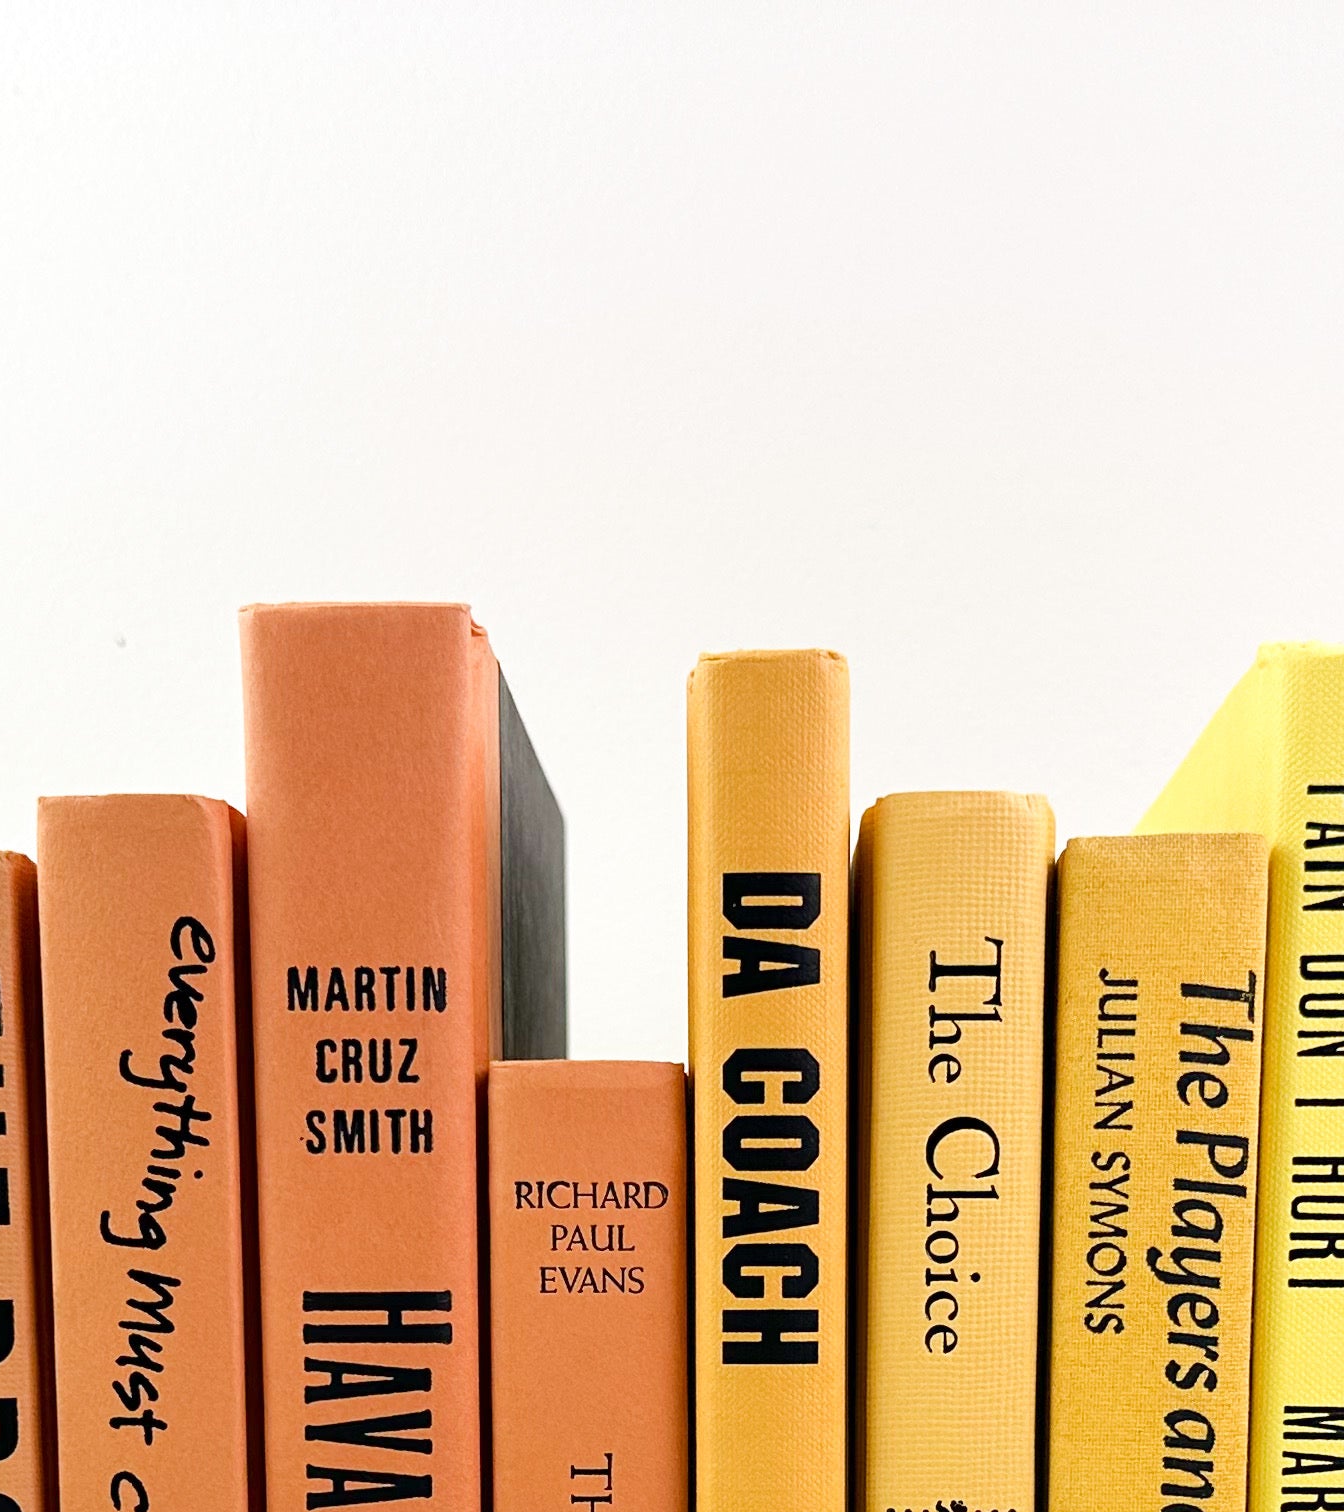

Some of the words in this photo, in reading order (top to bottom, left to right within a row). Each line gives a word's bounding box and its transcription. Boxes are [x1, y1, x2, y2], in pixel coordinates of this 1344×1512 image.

[287, 965, 447, 1013] MARTIN
[722, 871, 822, 999] DA
[315, 1037, 421, 1084] CRUZ
[928, 935, 1004, 1084] The
[1093, 967, 1139, 1131] JULIAN
[1176, 969, 1260, 1114] The
[99, 915, 216, 1251] everything
[305, 1108, 434, 1155] SMITH
[514, 1180, 669, 1210] RICHARD
[550, 1224, 636, 1252] PAUL
[721, 1047, 821, 1365] COACH
[924, 1116, 1001, 1355] Choice
[1083, 1151, 1131, 1335] SYMONS
[1145, 1129, 1251, 1394] Players
[539, 1266, 645, 1295] EVANS
